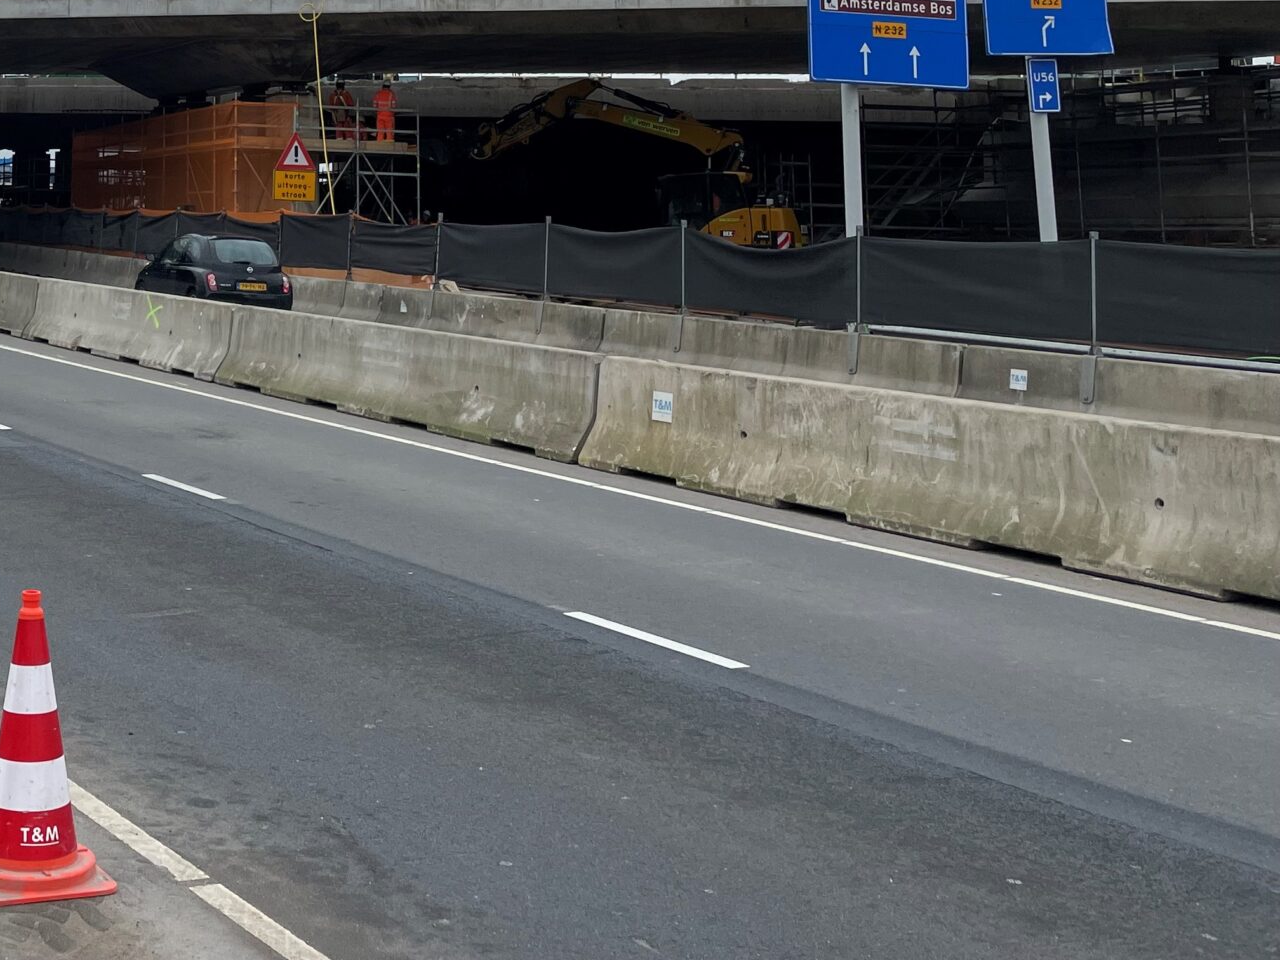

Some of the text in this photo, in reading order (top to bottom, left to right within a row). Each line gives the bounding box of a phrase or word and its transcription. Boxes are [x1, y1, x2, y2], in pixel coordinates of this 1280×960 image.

[930, 3, 953, 15] Bos
[1033, 72, 1055, 82] U56
[654, 399, 672, 412] T&M
[19, 825, 60, 843] T&M
